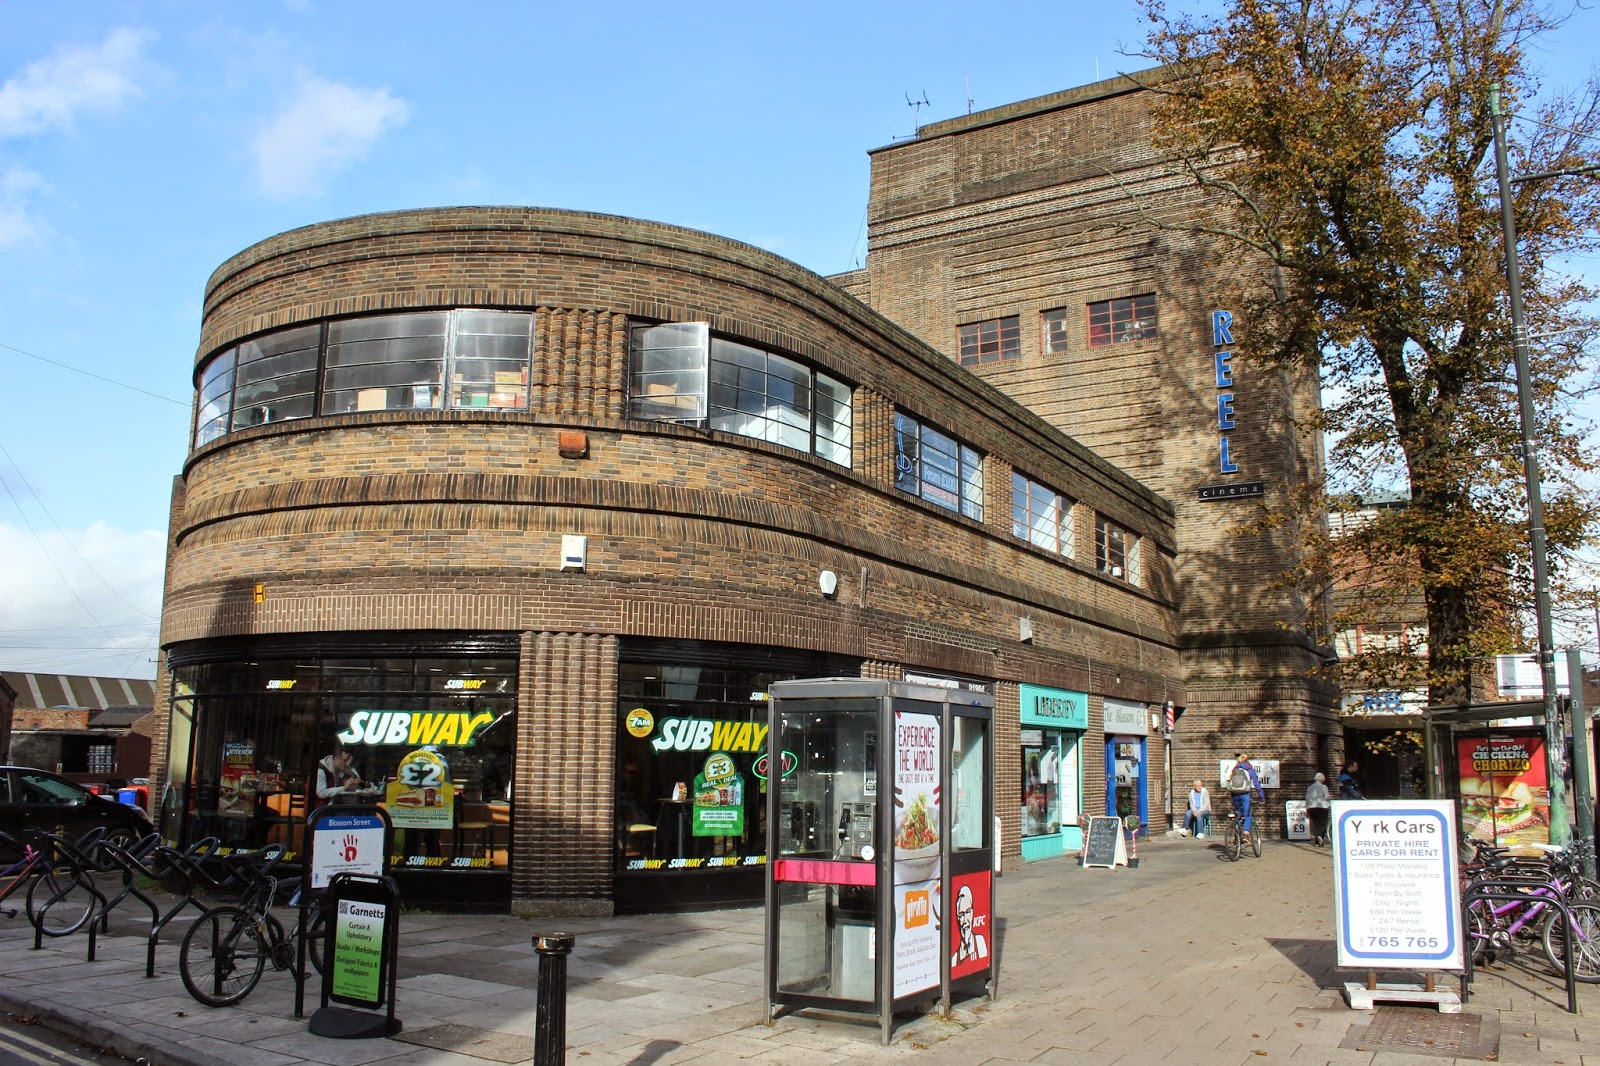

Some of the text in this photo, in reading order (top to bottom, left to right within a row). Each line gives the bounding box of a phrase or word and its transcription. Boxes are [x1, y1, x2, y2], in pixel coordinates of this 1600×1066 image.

[1212, 310, 1238, 473] REEL
[1202, 485, 1259, 497] cinema
[266, 679, 297, 690] SUBWAY
[444, 679, 487, 690] SUBWAY
[749, 691, 769, 701] SUBW
[1034, 696, 1077, 720] LIBERTY
[337, 708, 494, 746] SUBWAY
[629, 717, 651, 728] 7AM
[652, 719, 769, 752] SUBWAY
[898, 725, 935, 748] EXPERIENCE
[758, 758, 792, 773] ON
[899, 749, 910, 771] THE
[1472, 759, 1531, 771] CHORIZO
[708, 760, 731, 777] £3
[400, 763, 442, 786] £2
[701, 775, 738, 789] REAL DEAL
[1258, 776, 1270, 785] air
[328, 818, 371, 827] Blossom Street
[1292, 823, 1305, 833] £9
[1351, 820, 1436, 834] Yrk Cars
[1356, 840, 1430, 848] PRIVATE HIRE
[264, 850, 297, 861] SUBAY
[1350, 849, 1439, 857] CARS FOR RENT
[406, 855, 448, 866] SUBWAY
[451, 857, 494, 868] SUBWAY
[627, 859, 667, 870] SUBWAY
[668, 858, 705, 869] SUBWAY
[707, 856, 741, 867] SUBWAY
[743, 855, 767, 866] SUBWA
[1375, 872, 1395, 880] Tyres
[1393, 890, 1403, 898] By
[349, 905, 384, 919] Garnetts
[906, 896, 927, 923] giraffe
[349, 922, 366, 931] Curtain
[972, 914, 986, 928] KFC
[346, 931, 372, 942] Upholstery
[1367, 936, 1400, 947] 765
[1405, 937, 1438, 948] 765
[336, 942, 351, 952] Studio
[355, 945, 380, 957] Workshops
[336, 956, 357, 966] Designer
[357, 959, 374, 969] Fabrics
[343, 967, 369, 978] wallpapers
